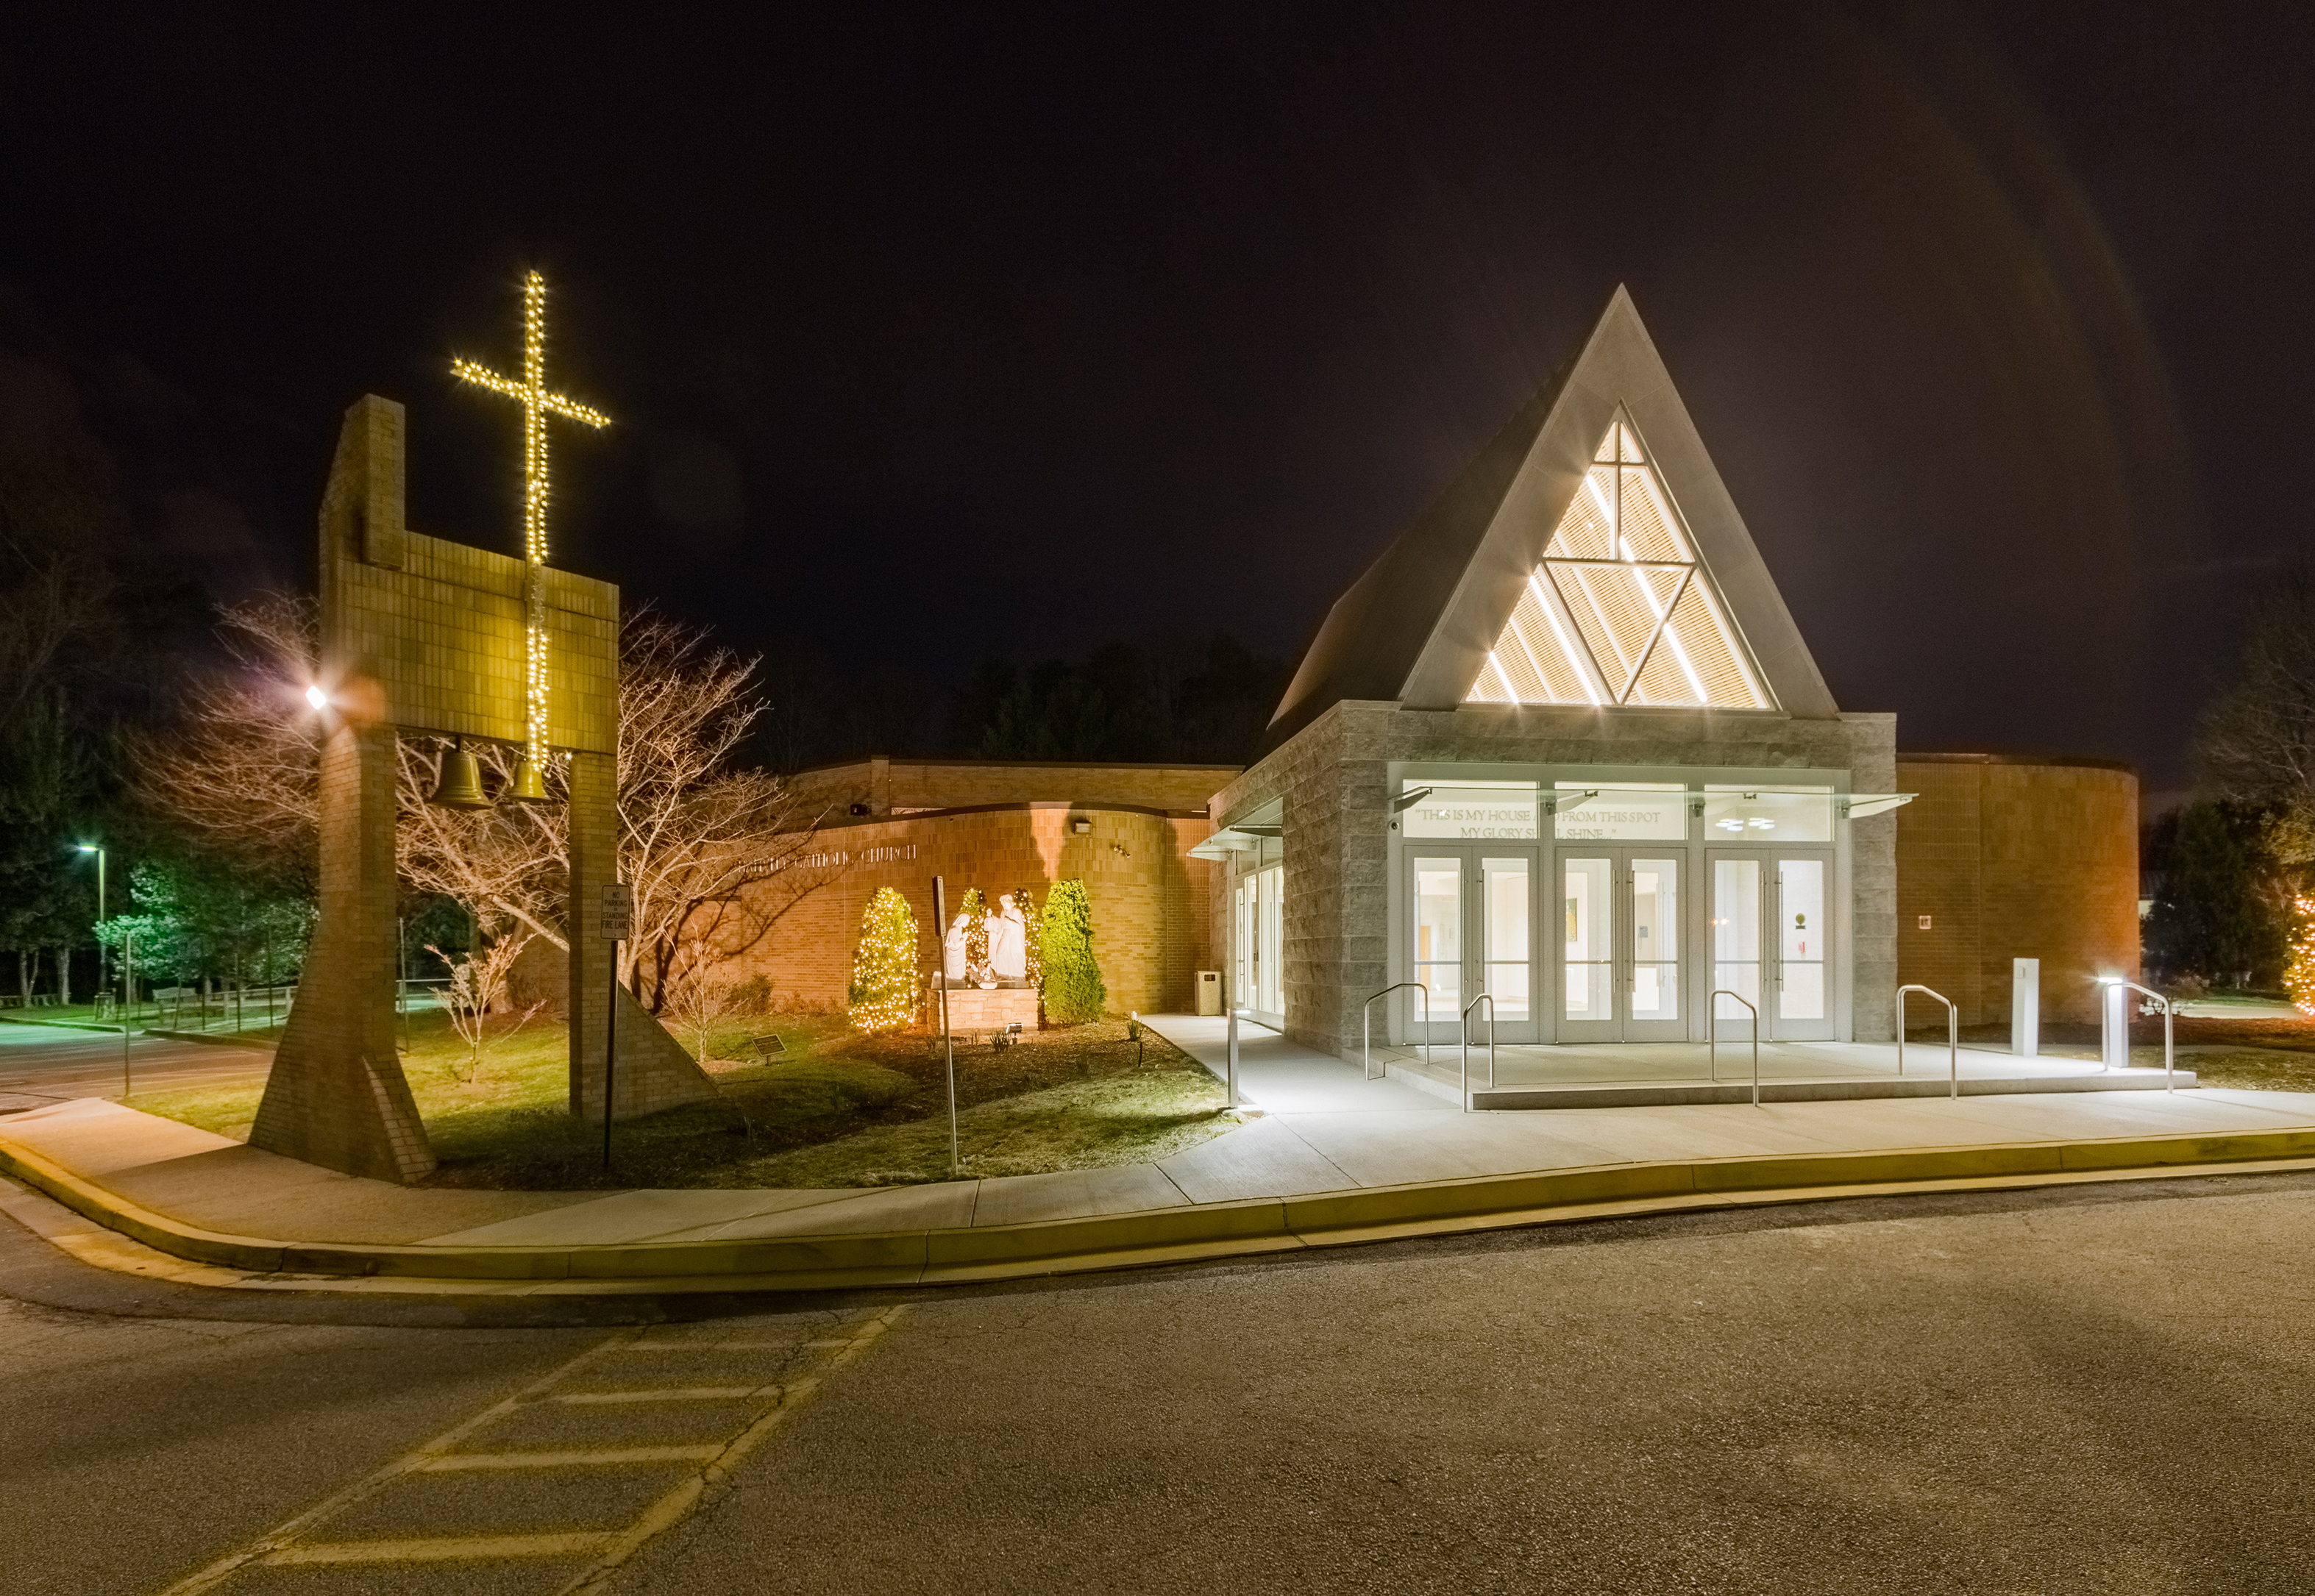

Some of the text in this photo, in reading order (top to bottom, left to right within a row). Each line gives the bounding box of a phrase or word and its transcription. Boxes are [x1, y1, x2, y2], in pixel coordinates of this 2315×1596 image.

[1453, 810, 1464, 821] IS
[1466, 810, 1485, 821] MY
[1488, 810, 1530, 822] HOUSE
[1562, 811, 1597, 822] FROM
[1599, 811, 1627, 822] THIS
[1629, 811, 1661, 823] SPOT
[1461, 827, 1481, 838] MY
[1483, 827, 1523, 839] GLORY
[1525, 827, 1564, 839] SHL
[794, 851, 855, 870] CATHOLIC
[861, 844, 917, 865] CHURCH
[604, 899, 627, 908] PARKING
[602, 912, 628, 920] STANDING
[602, 920, 627, 930] FIRE LANE
